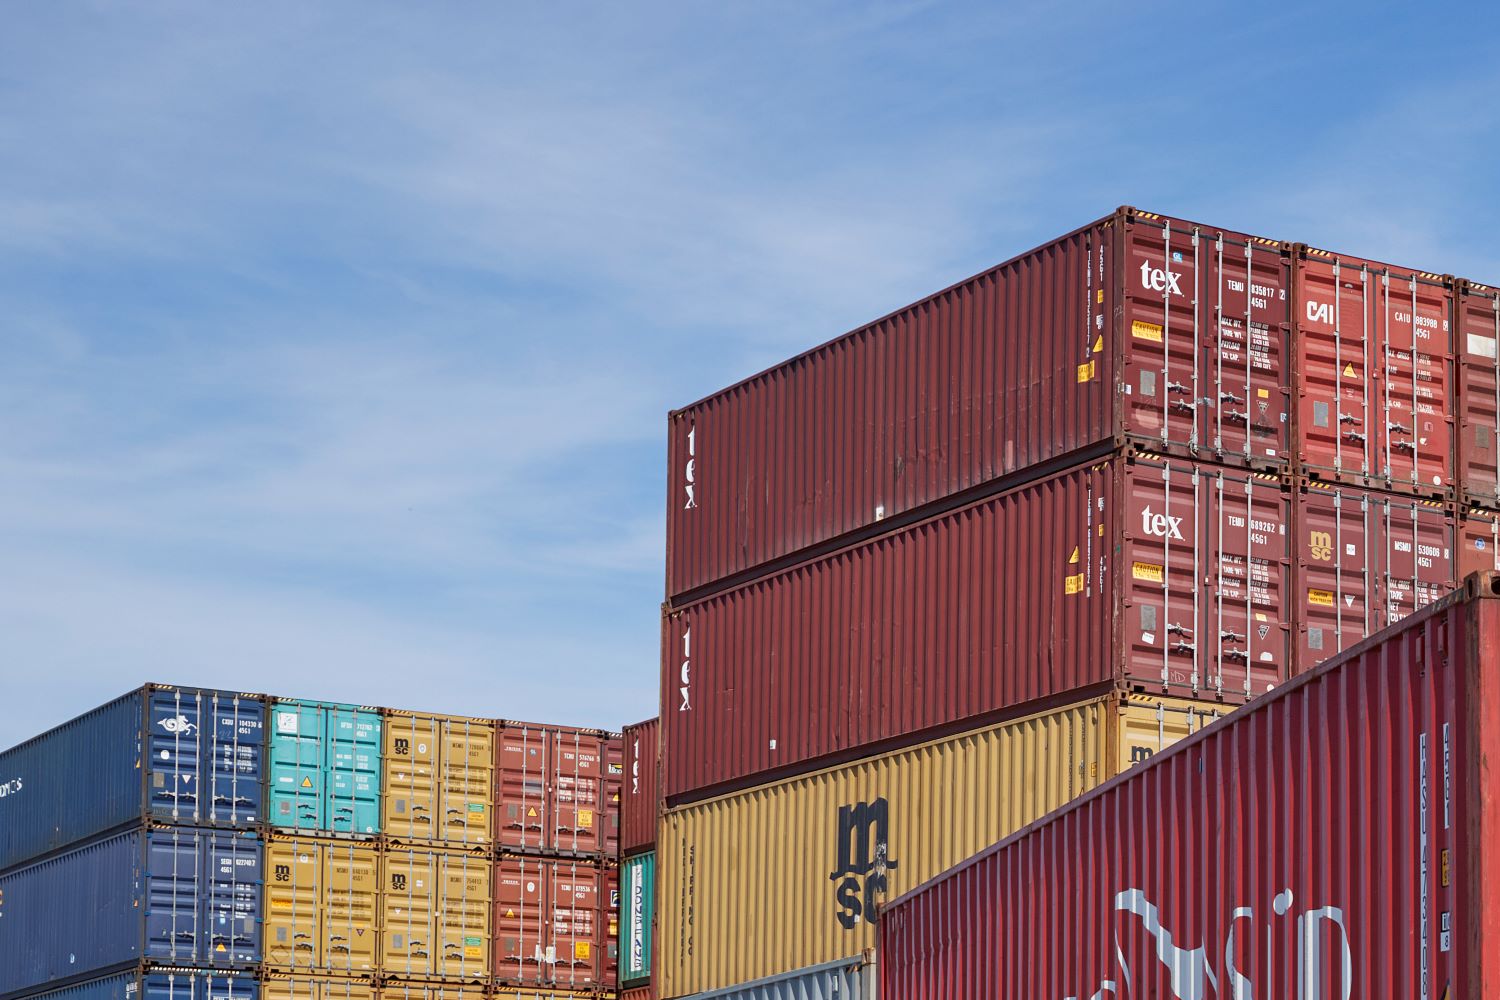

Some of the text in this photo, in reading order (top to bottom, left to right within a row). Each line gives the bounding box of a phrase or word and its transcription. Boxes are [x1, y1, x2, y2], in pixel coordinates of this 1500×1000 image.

[1140, 260, 1183, 296] tex
[1227, 280, 1244, 292] TEMU
[1251, 298, 1267, 309] 45G1
[1306, 300, 1334, 324] CAI
[1395, 312, 1411, 324] CAIU
[1416, 328, 1430, 340] 45G1
[1142, 505, 1184, 540] tex
[1228, 516, 1276, 533] TEMU 689262
[1251, 533, 1268, 545] 45G1
[1394, 541, 1411, 552] MSMU
[1418, 545, 1440, 558] 530606
[1418, 558, 1432, 568] 45G1
